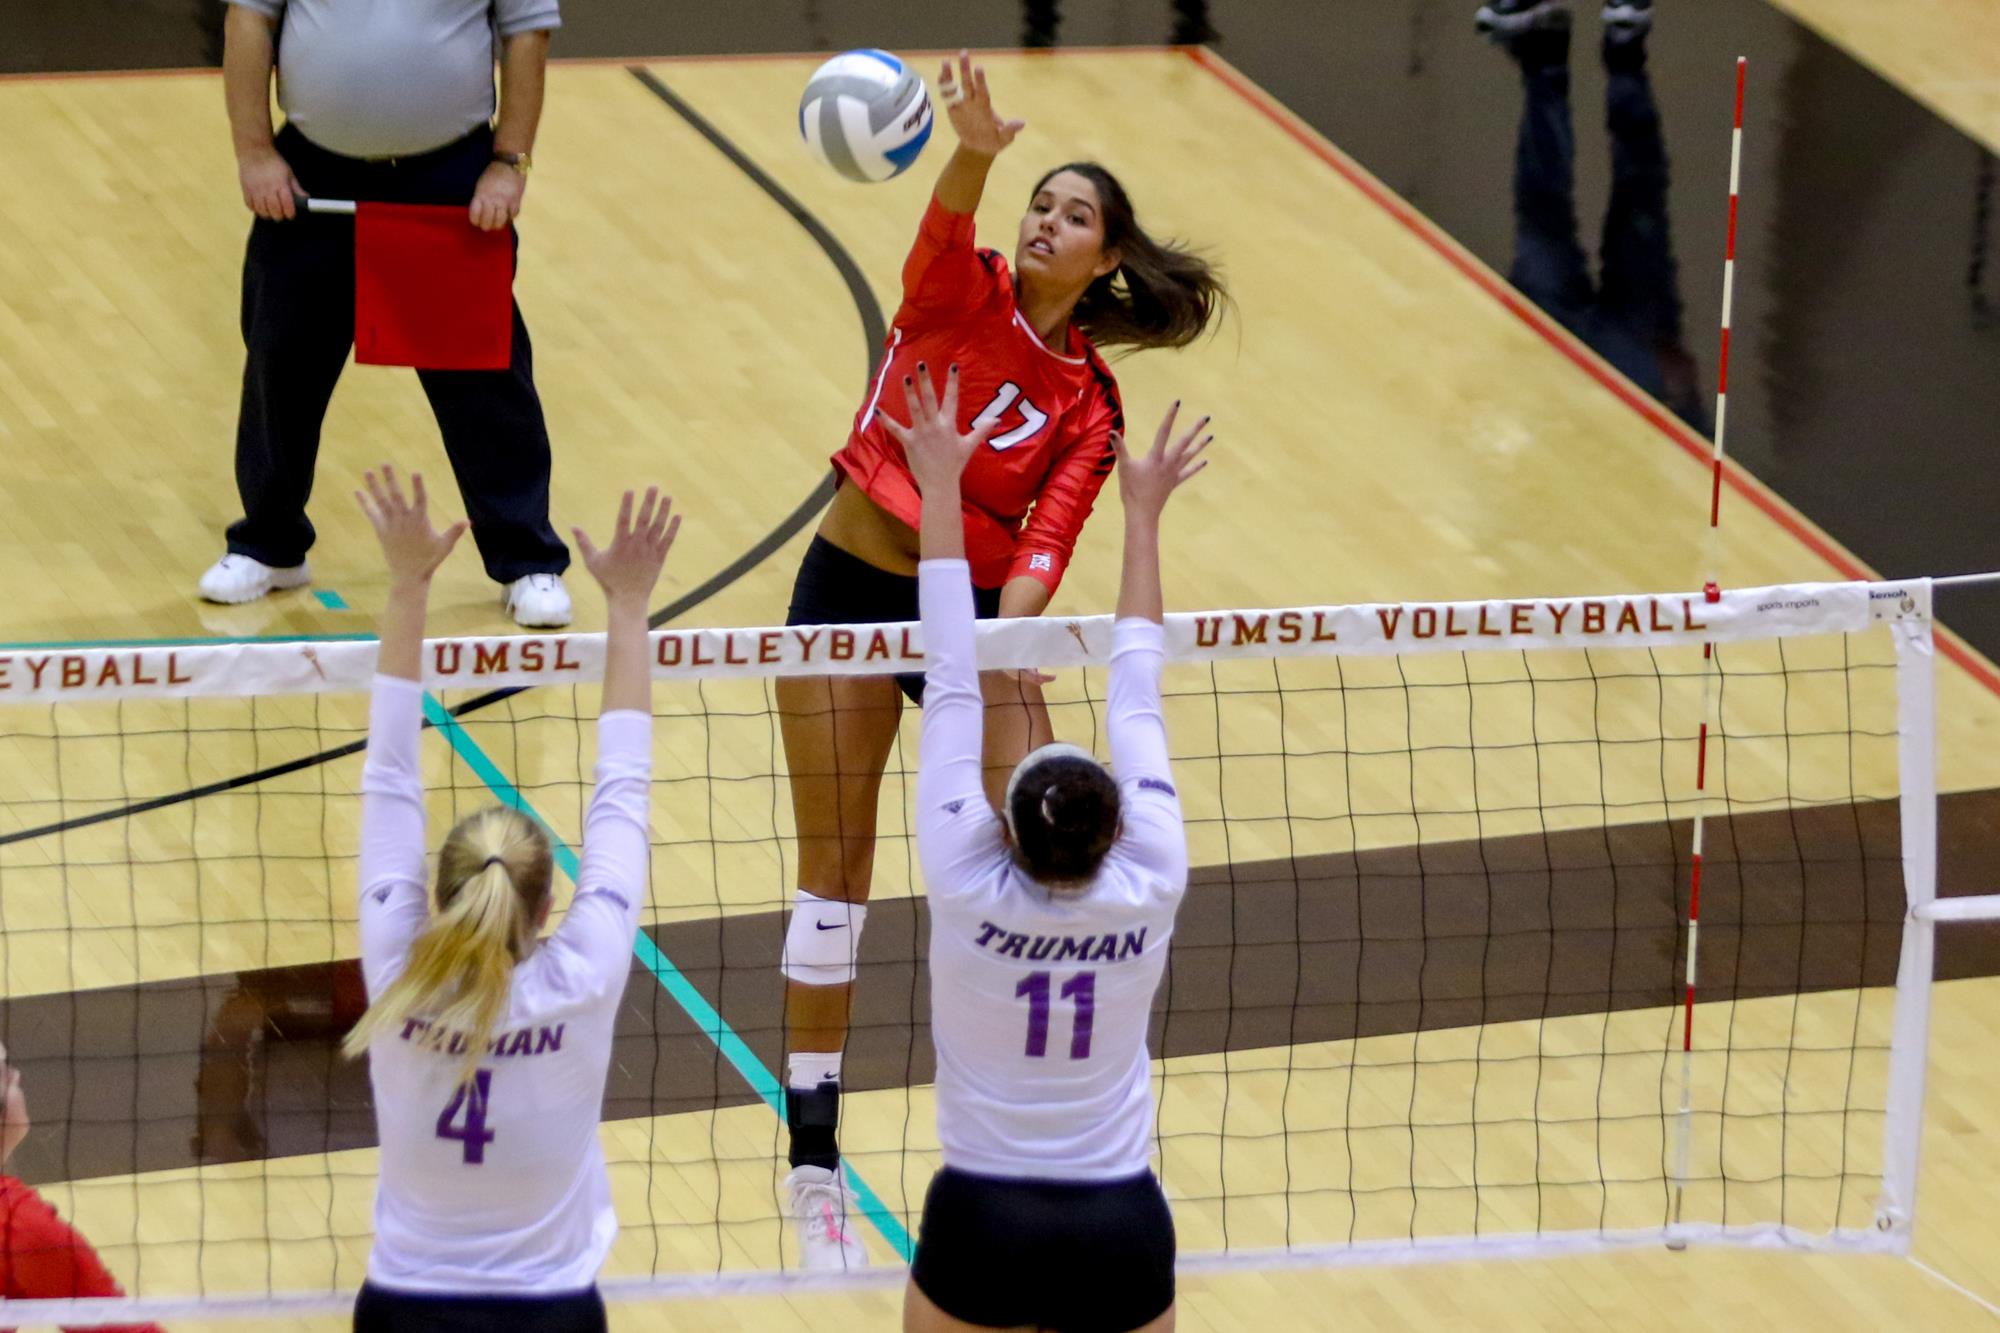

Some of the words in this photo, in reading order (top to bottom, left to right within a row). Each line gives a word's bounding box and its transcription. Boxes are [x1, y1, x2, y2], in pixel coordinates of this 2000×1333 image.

[970, 380, 1049, 452] 17
[434, 640, 581, 675] UMSL
[656, 627, 925, 667] OLLEYBAL
[1194, 612, 1337, 647] UMSL
[1376, 599, 1707, 641] VOLLEYBALL
[974, 920, 1148, 962] TRUMAN
[1015, 970, 1096, 1060] 11
[436, 1068, 495, 1164] 4
